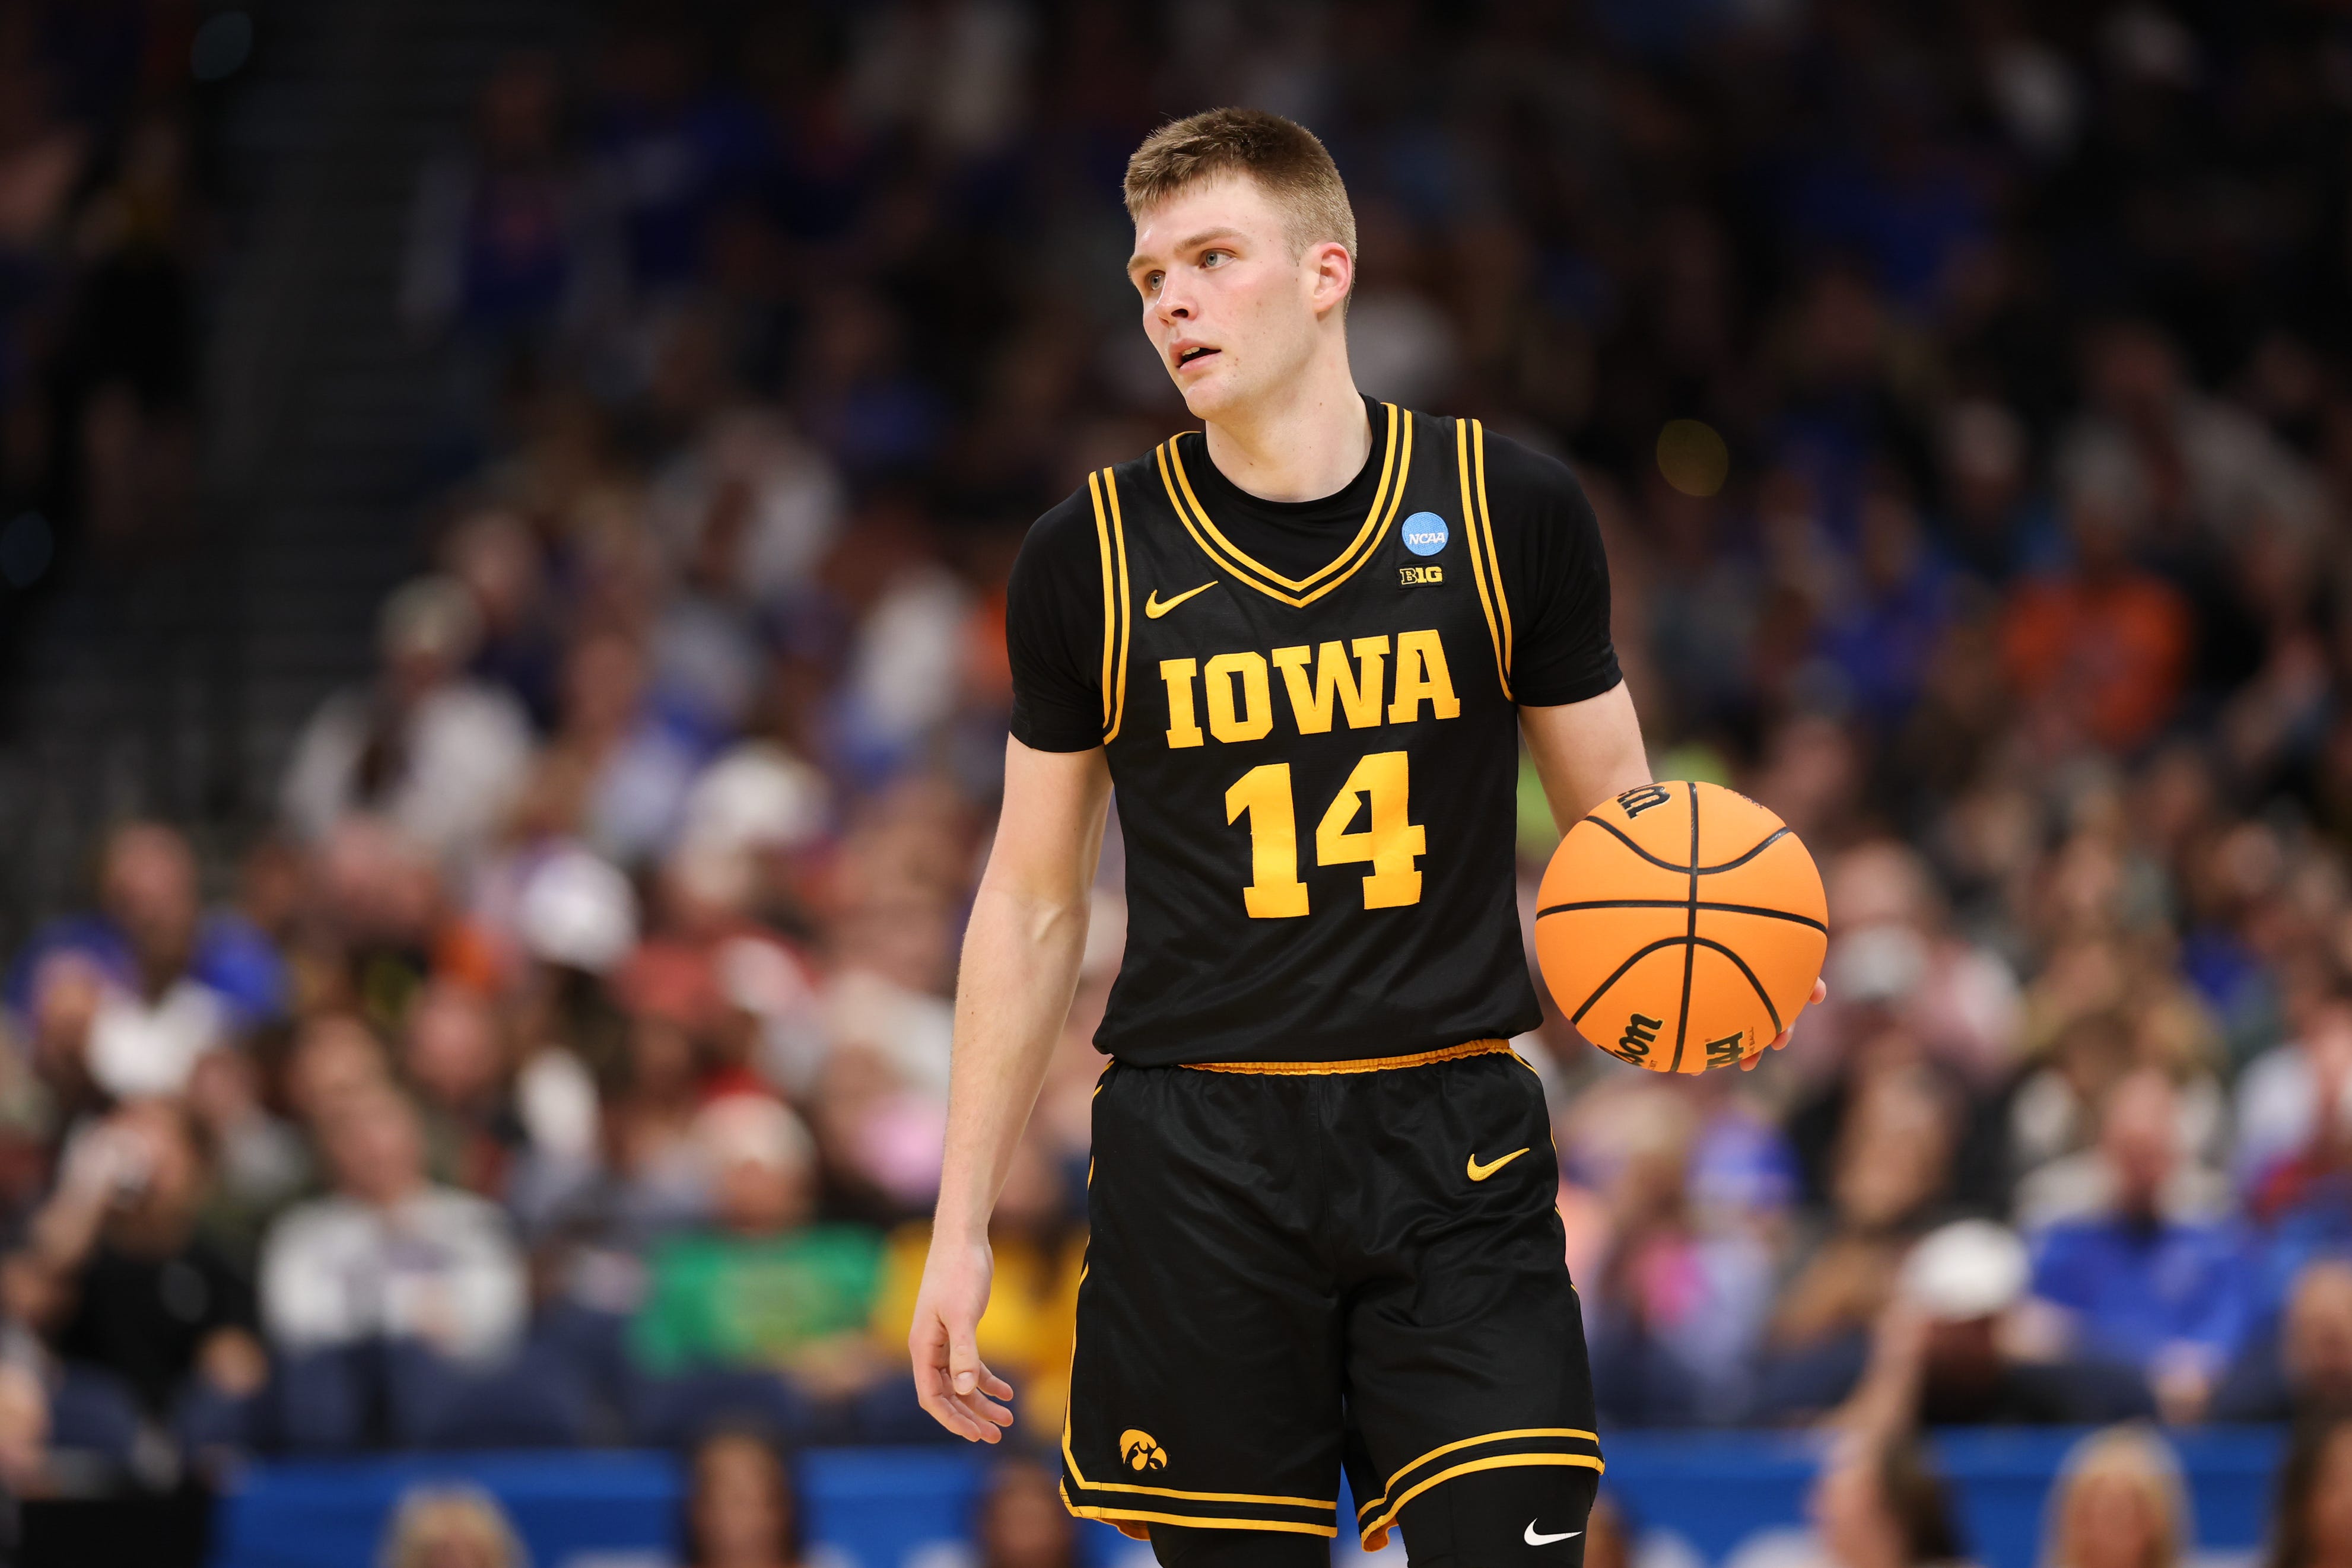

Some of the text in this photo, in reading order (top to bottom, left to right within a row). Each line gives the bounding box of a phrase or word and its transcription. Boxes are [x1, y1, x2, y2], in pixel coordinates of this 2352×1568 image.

[1409, 532, 1445, 545] NCAA
[1159, 629, 1460, 749] IOWA
[1225, 750, 1426, 918] 14
[1597, 1012, 1664, 1067] son
[1705, 1031, 1744, 1070] AA
